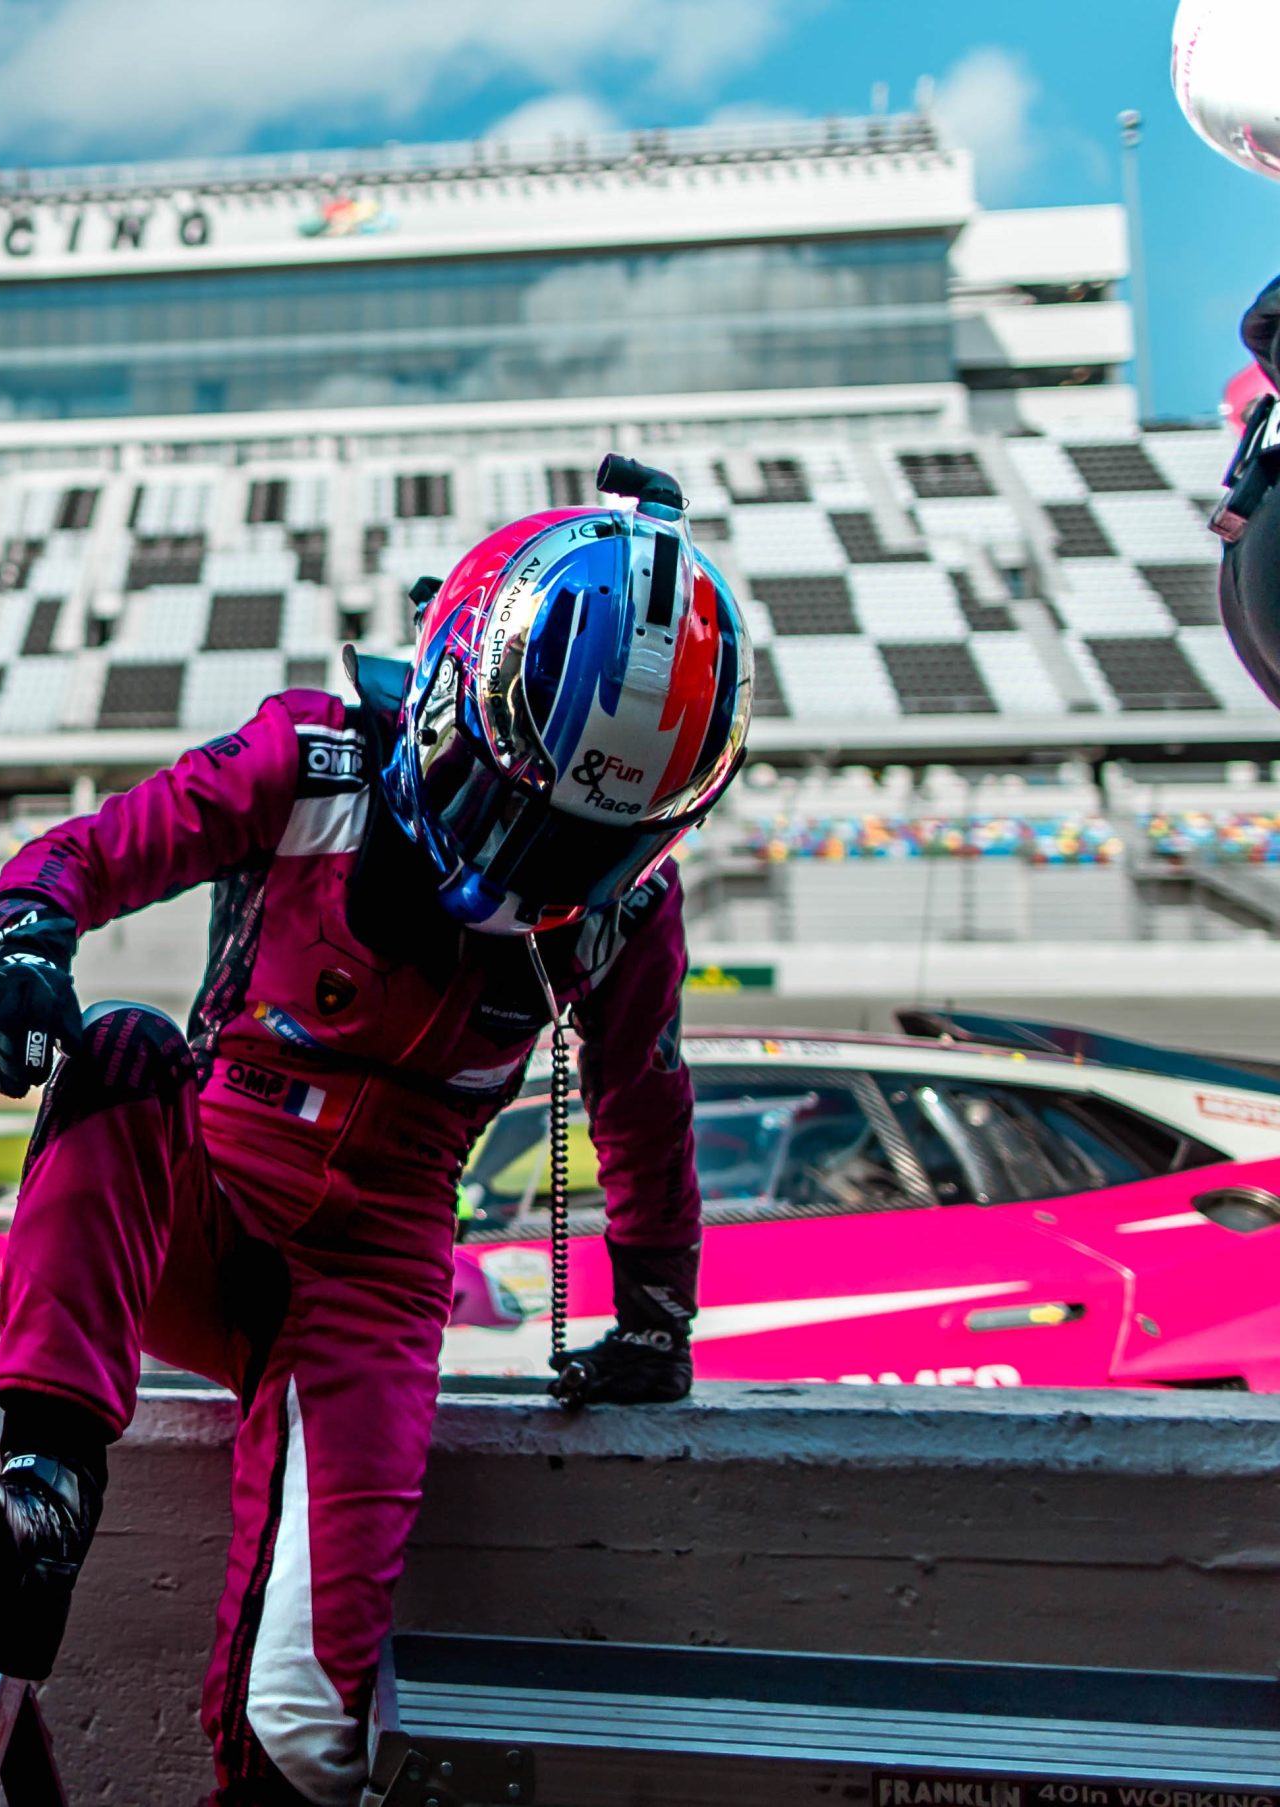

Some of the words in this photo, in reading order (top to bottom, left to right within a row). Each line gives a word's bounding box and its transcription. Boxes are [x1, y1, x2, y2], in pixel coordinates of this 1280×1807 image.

[500, 557, 540, 622] ALFANO
[308, 747, 363, 775] OMP
[602, 755, 644, 784] Fun
[584, 786, 642, 815] Race
[481, 1004, 532, 1021] Weather
[28, 1031, 47, 1067] OMP
[225, 1062, 288, 1098] OMP
[878, 1777, 1021, 1807] FRANKLIN
